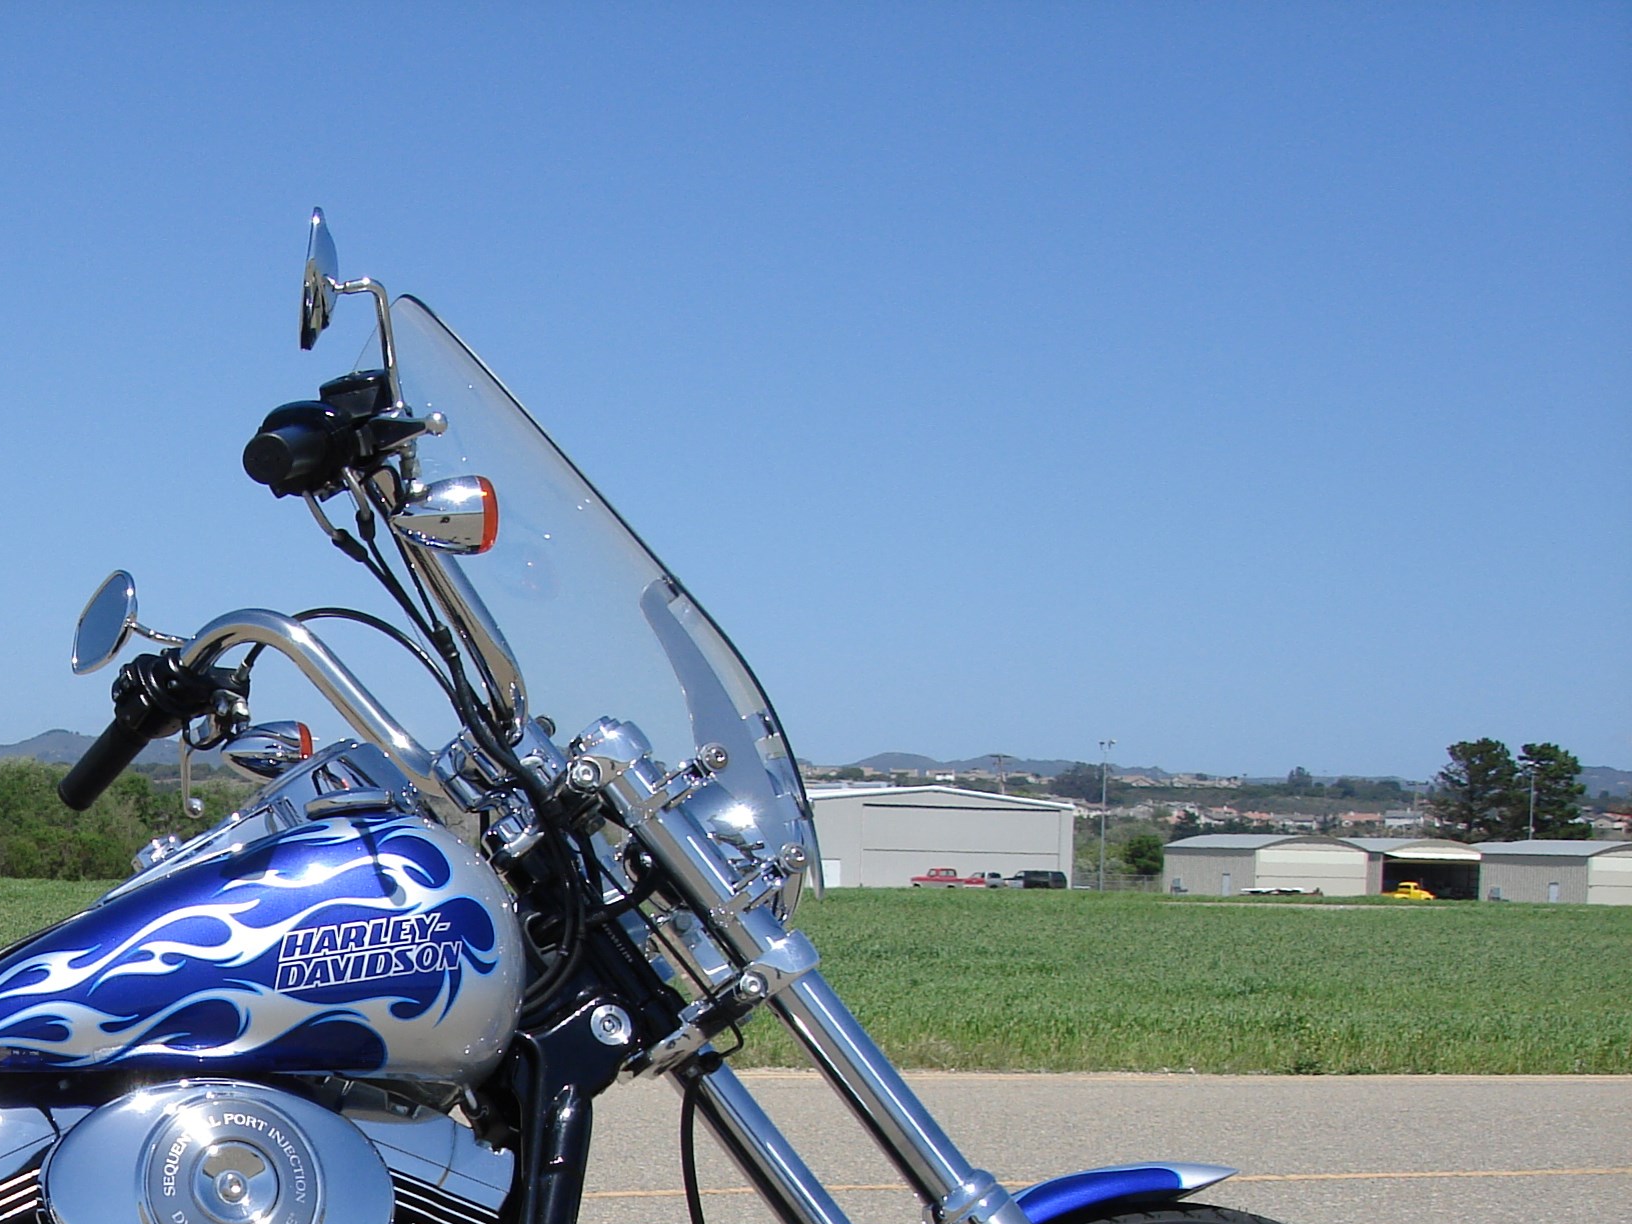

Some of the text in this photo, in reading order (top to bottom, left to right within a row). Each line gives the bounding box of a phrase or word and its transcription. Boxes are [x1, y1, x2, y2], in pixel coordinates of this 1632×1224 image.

[279, 912, 451, 963] HARLEY-
[275, 941, 463, 993] DAVIDSON
[163, 1112, 307, 1204] SEQUENL PORT INJECTION
